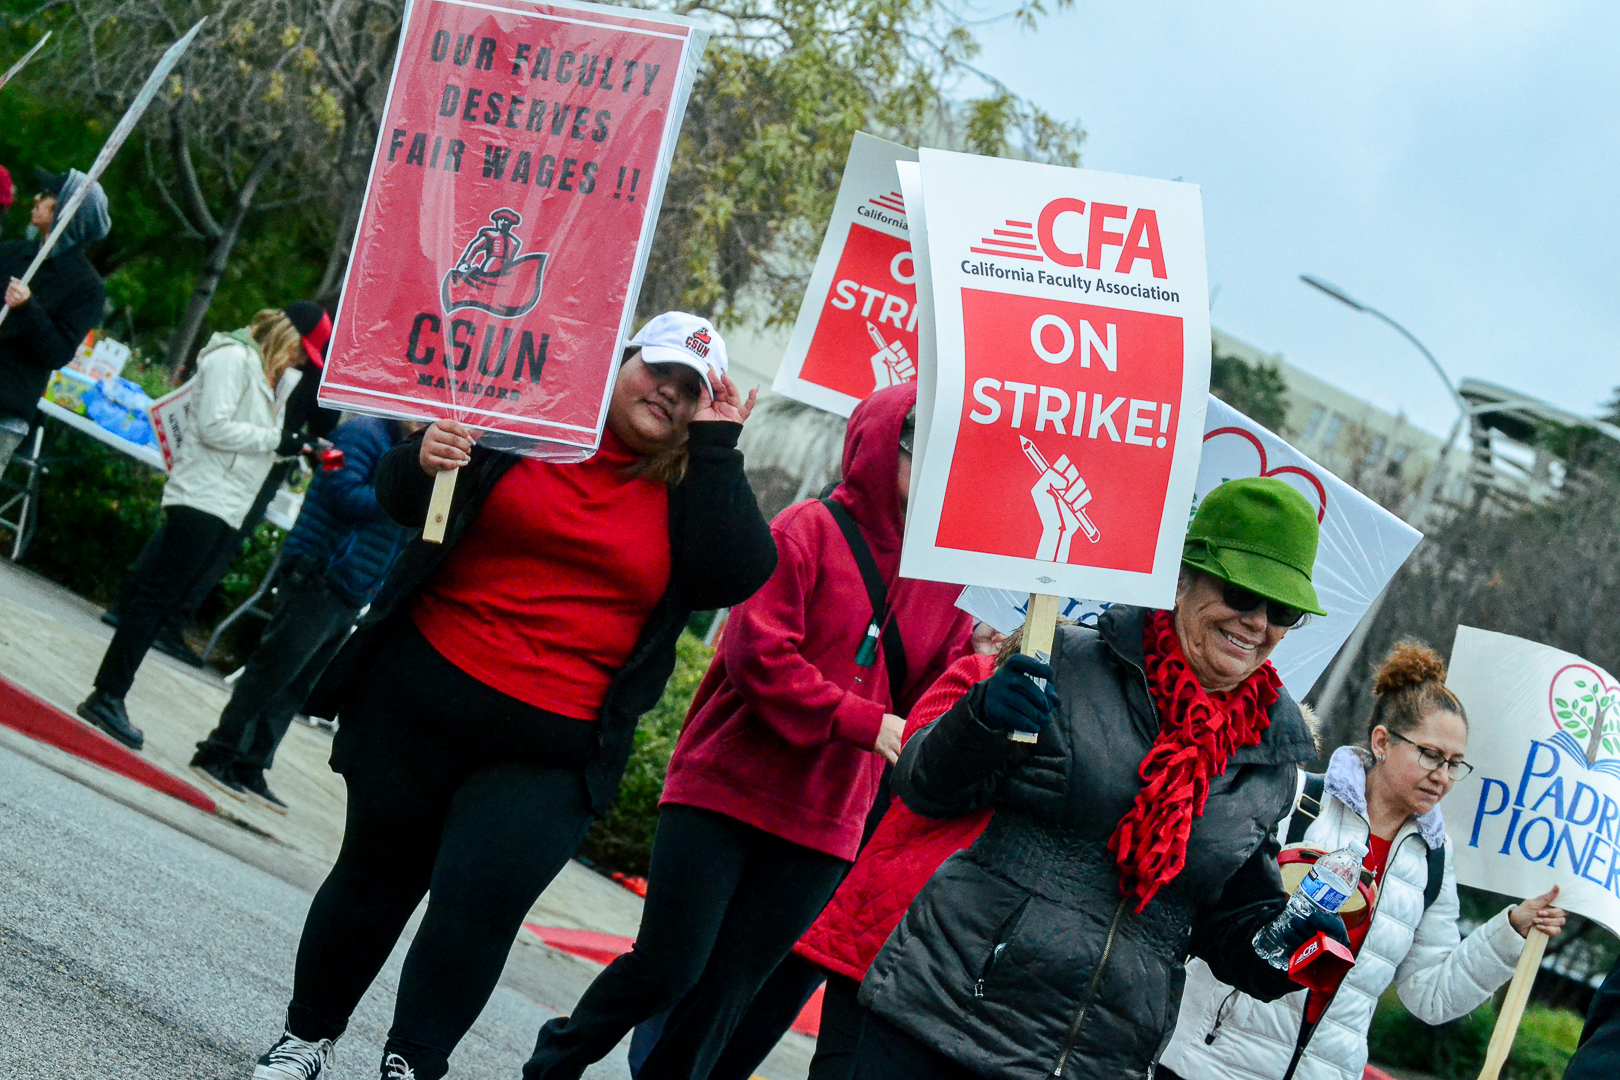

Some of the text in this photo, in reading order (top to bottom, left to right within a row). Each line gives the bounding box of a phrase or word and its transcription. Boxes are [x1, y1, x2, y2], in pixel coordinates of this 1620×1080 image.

[430, 29, 661, 97] OUR FACULTY
[439, 84, 612, 143] DESERVES
[387, 128, 641, 201] FAIR WAGES !!
[857, 205, 909, 231] California
[1037, 197, 1168, 280] CFA
[889, 251, 917, 285] O
[961, 260, 1180, 303] California Faculty Association
[831, 279, 919, 333] STRI
[406, 312, 550, 385] CSUN
[685, 335, 711, 358] CSUN
[1030, 314, 1118, 372] ON
[969, 377, 1172, 449] STRIKE!
